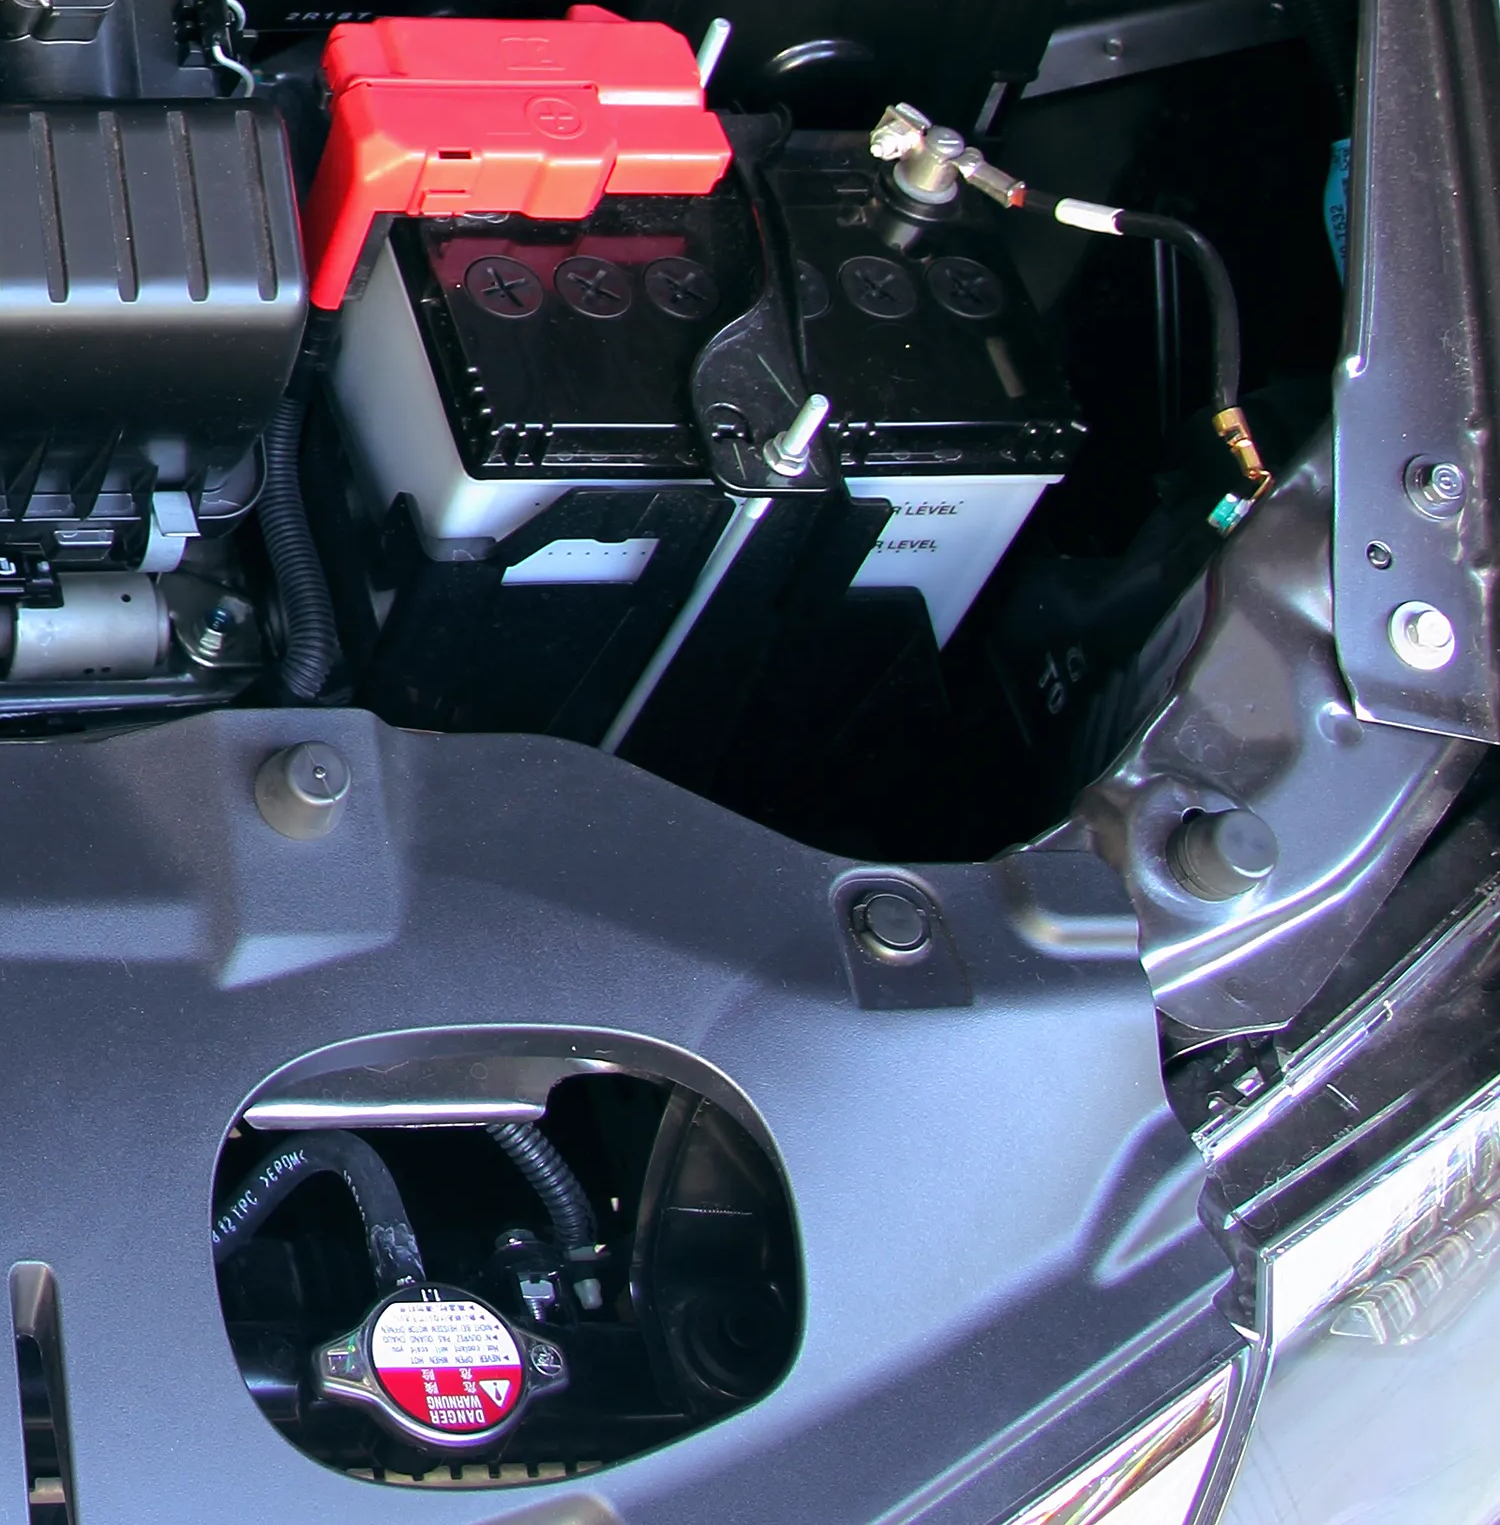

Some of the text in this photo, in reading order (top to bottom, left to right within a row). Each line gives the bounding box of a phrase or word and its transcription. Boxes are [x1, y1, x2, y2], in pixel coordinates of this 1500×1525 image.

[905, 505, 958, 515] LEVEL
[887, 540, 938, 549] LEVEL
[421, 1288, 441, 1302] 1.1
[410, 1355, 424, 1365] HOT
[455, 1355, 474, 1364] OPEN
[426, 1395, 483, 1409] WARNUNG
[429, 1409, 486, 1424] DANGER
